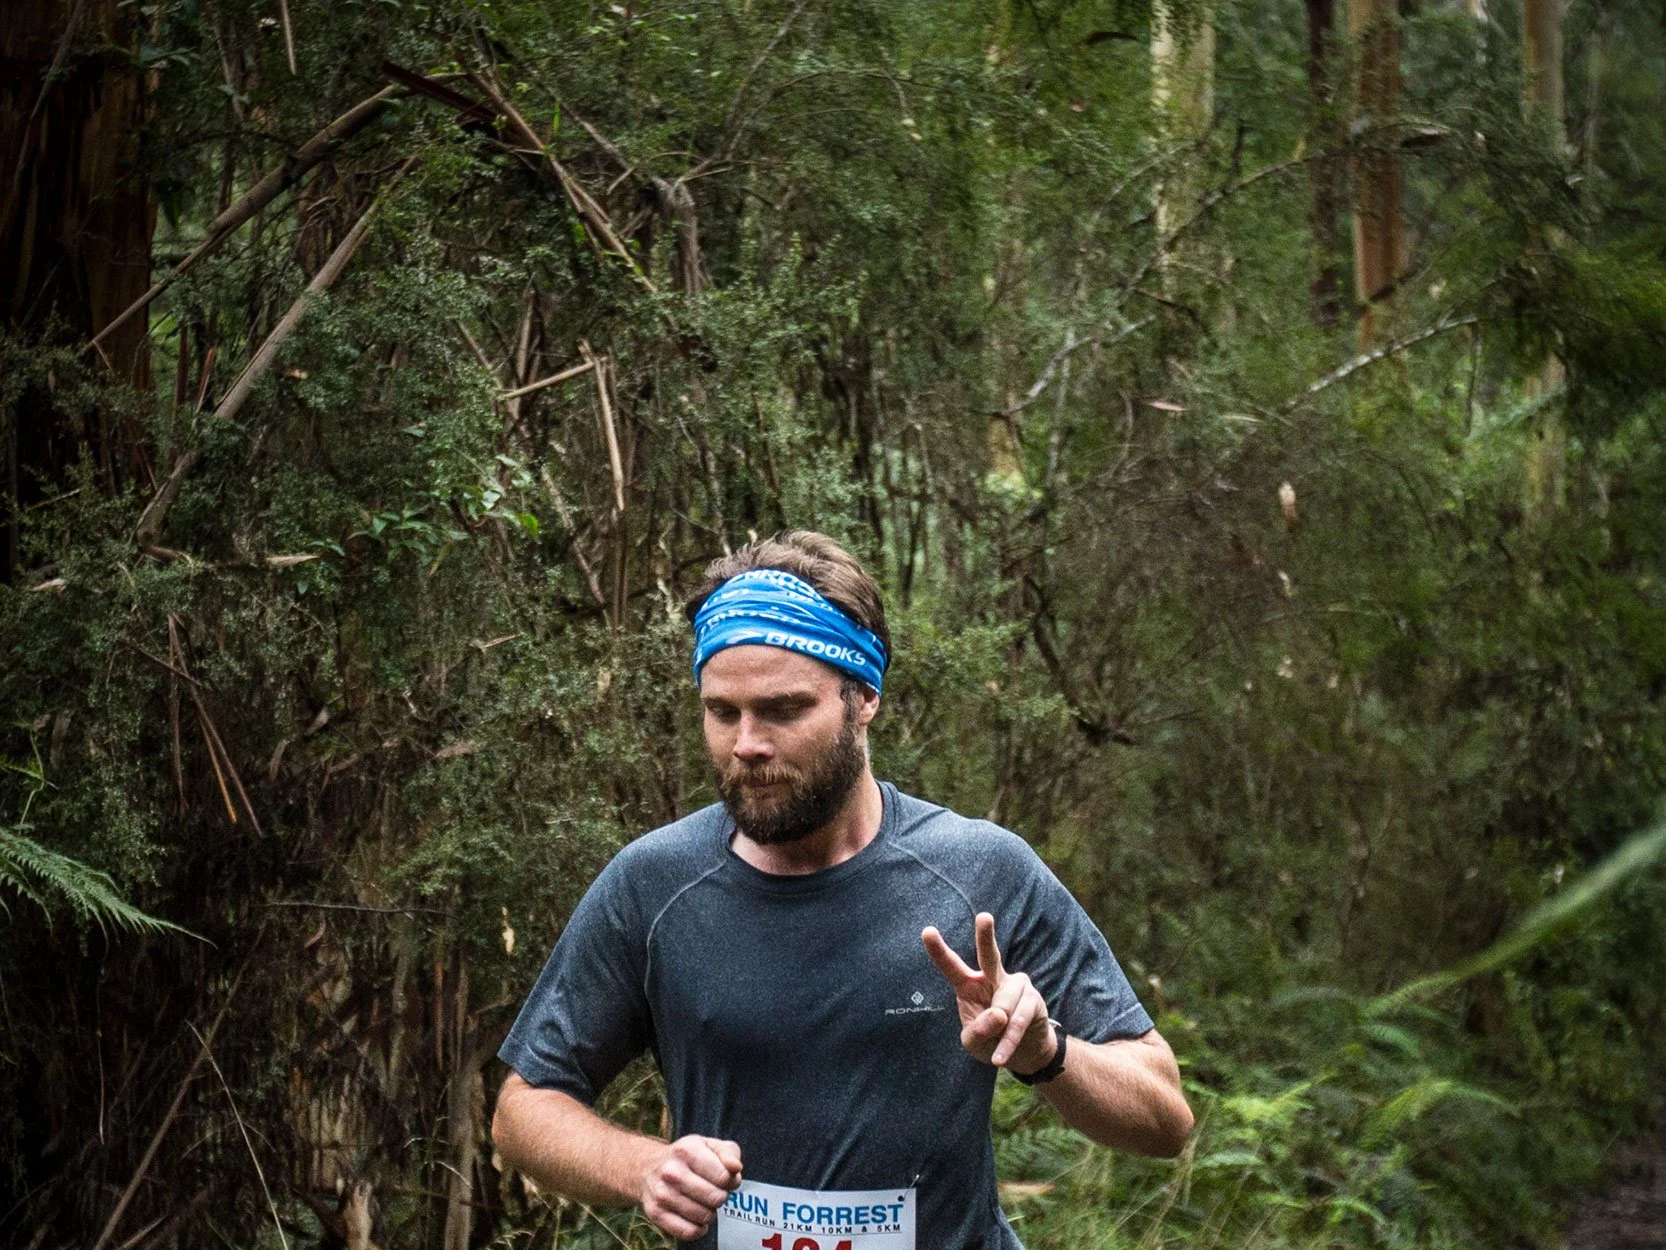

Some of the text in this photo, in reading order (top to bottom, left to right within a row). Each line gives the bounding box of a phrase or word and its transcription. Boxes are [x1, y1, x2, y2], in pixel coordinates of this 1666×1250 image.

[765, 632, 867, 666] BROOKS
[723, 1207, 752, 1221] TRAIL
[755, 1216, 776, 1227] RUN
[783, 1222, 812, 1232] 21KM
[822, 1226, 852, 1234] 10KM
[877, 1224, 901, 1232] 5KM
[782, 1203, 904, 1226] FORREST
